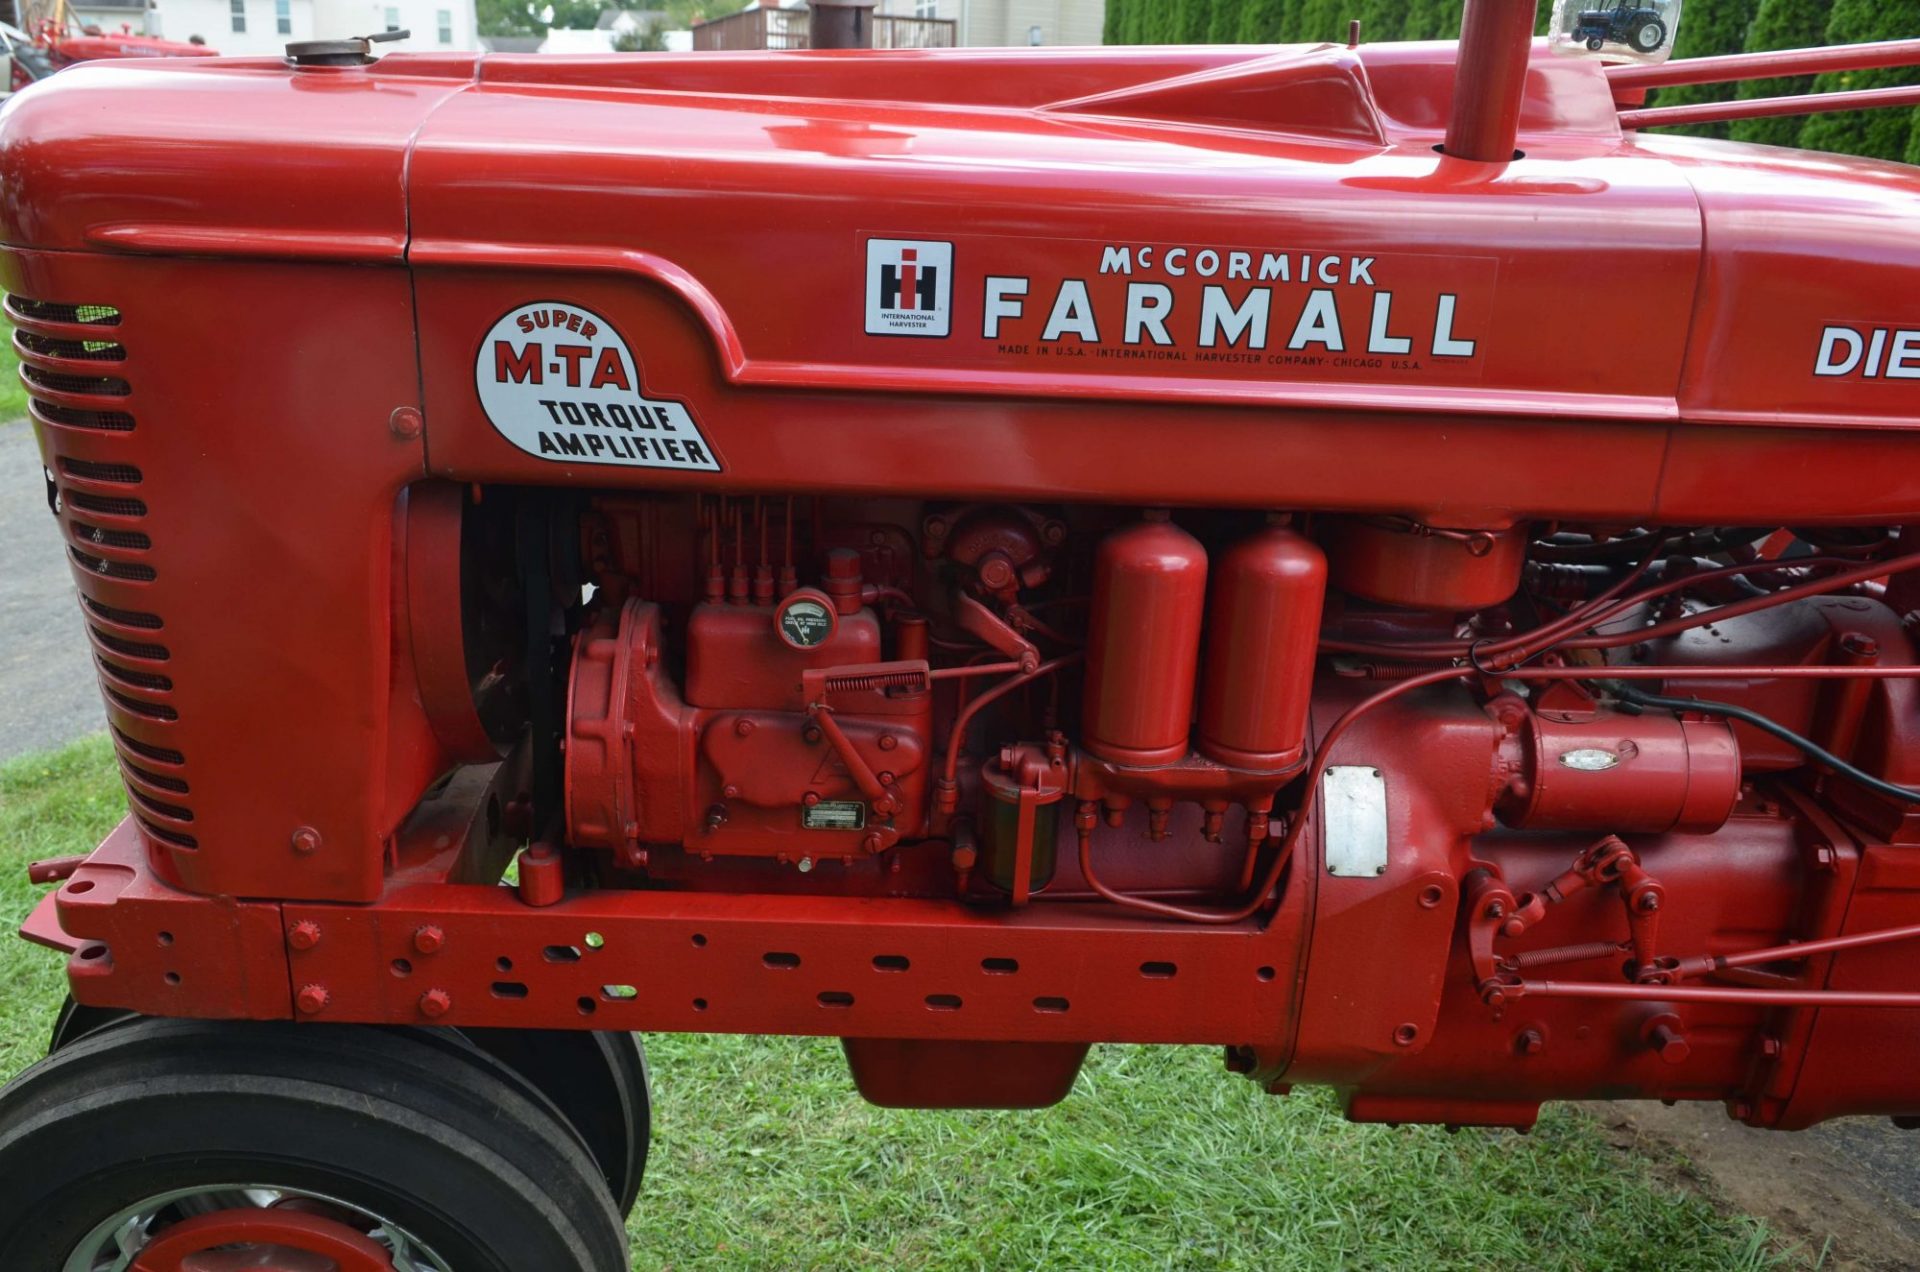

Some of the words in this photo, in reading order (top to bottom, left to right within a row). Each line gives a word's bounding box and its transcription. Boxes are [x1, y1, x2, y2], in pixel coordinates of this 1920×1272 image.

[516, 309, 598, 341] SUPER
[881, 313, 935, 321] INTERNATIONAL
[982, 275, 1476, 358] FARMALL
[998, 344, 1029, 355] MADE
[1036, 346, 1048, 356] IN
[1096, 348, 1187, 361] INTERNATIONAL
[1195, 352, 1261, 364] HARVESTER
[1333, 357, 1382, 368] CHICAGO
[1812, 325, 1920, 380] DIE
[538, 400, 676, 432] TORQUE
[538, 431, 710, 464] AMPLIFIER
